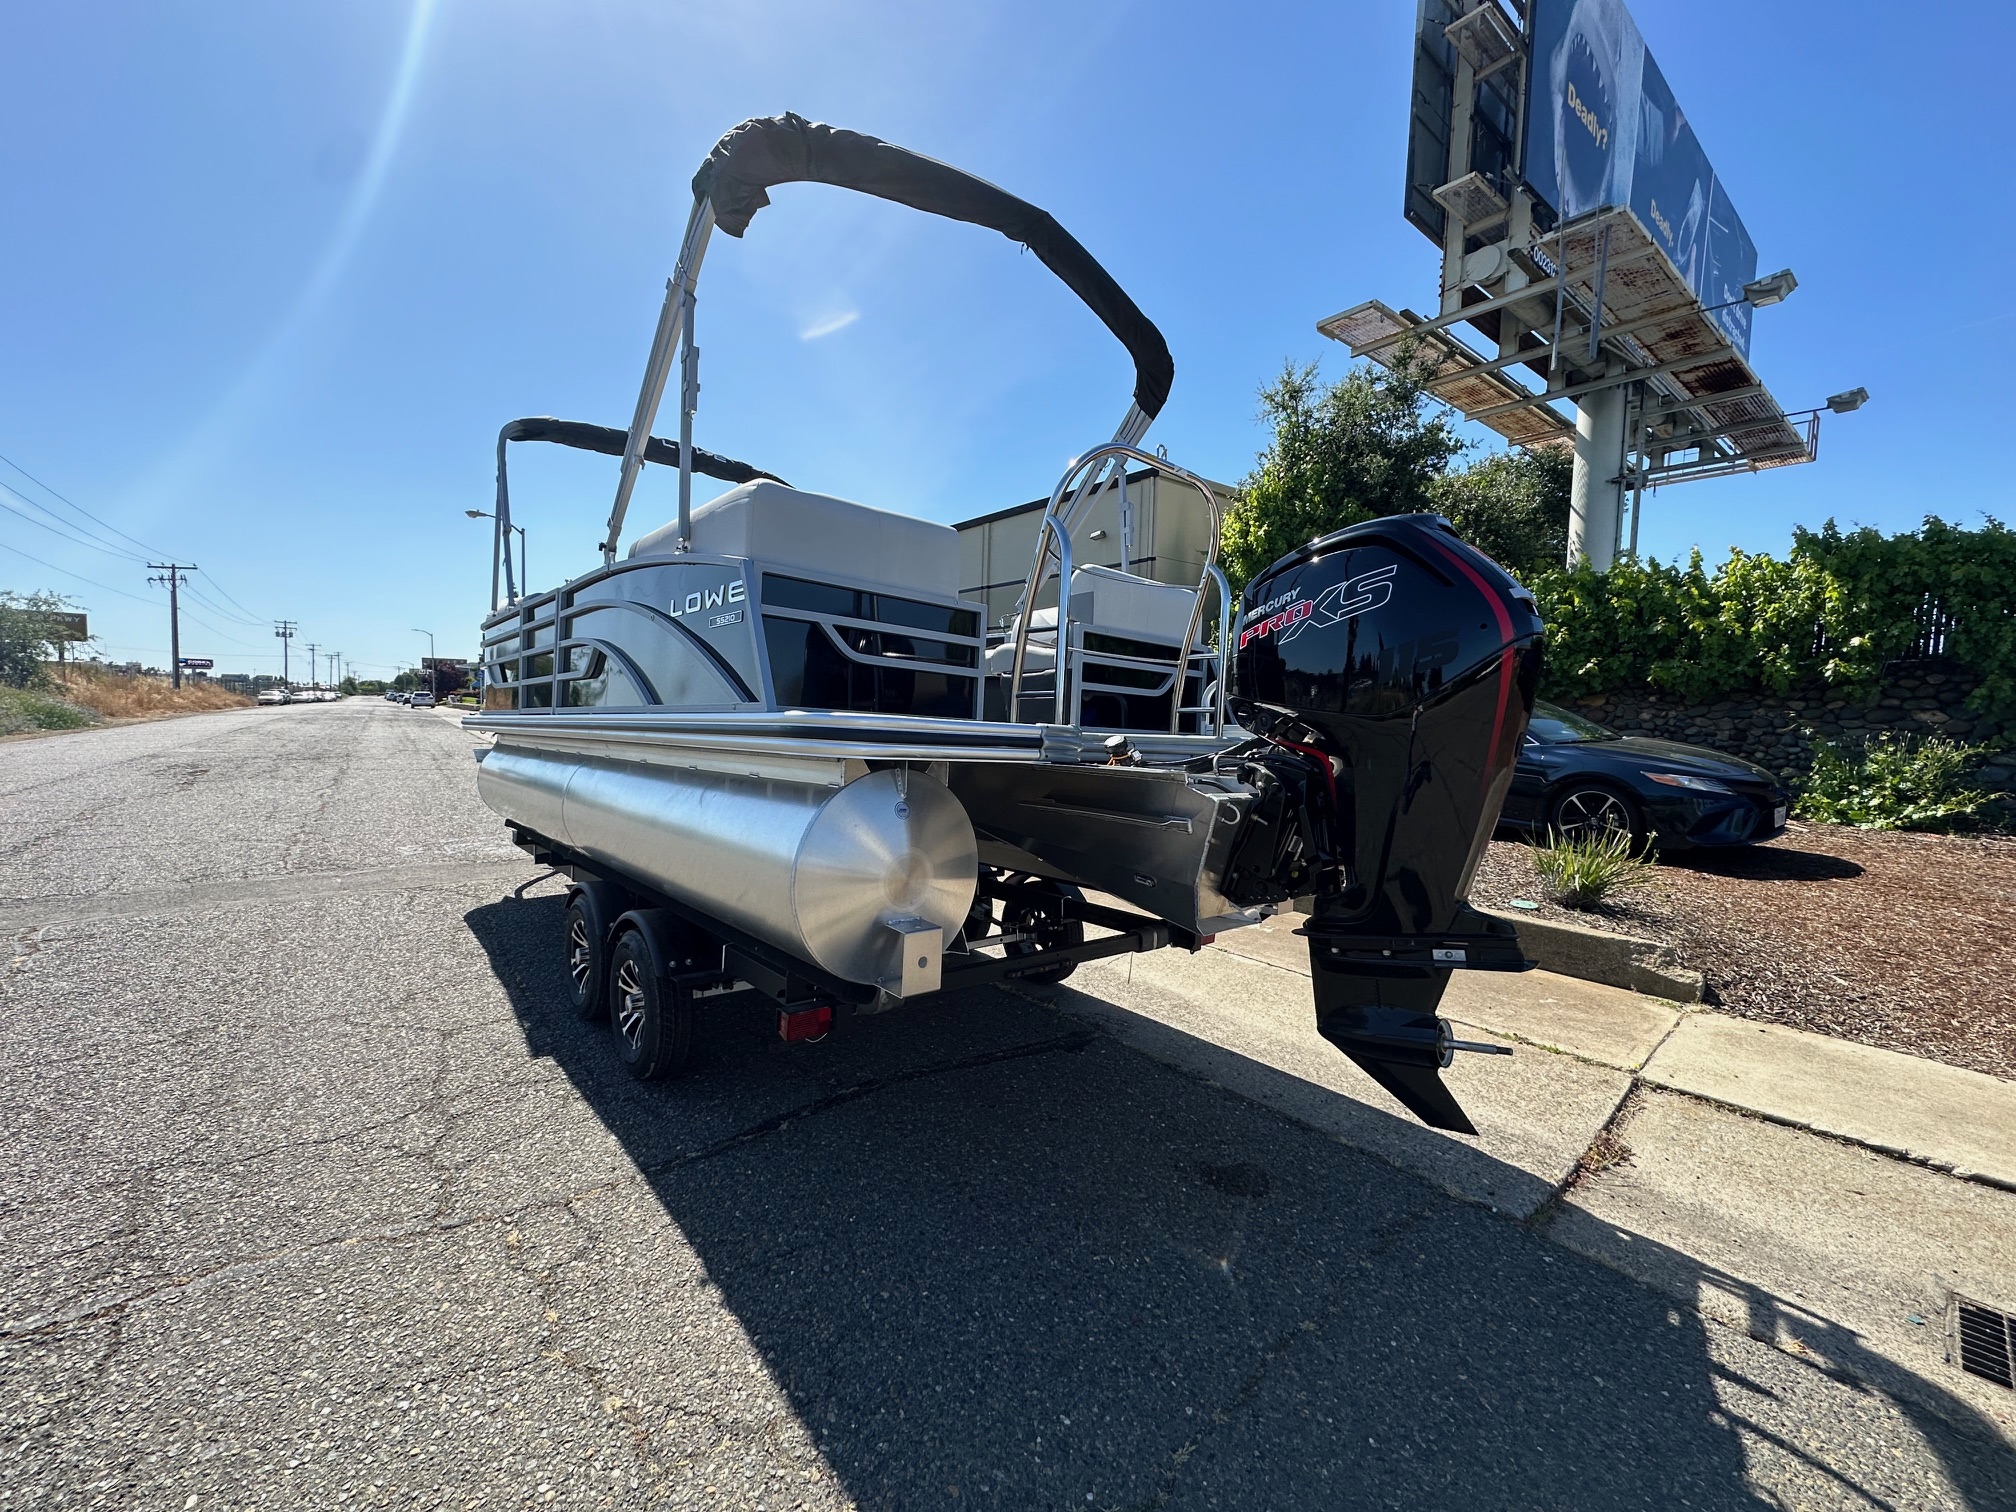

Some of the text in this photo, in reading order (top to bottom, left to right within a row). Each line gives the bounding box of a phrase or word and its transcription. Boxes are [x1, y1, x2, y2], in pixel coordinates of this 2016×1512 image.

[1568, 81, 1608, 150] Deadly?
[671, 579, 745, 617] LOWE
[1239, 564, 1398, 650] PRO XS
[1243, 586, 1301, 625] MERCURY
